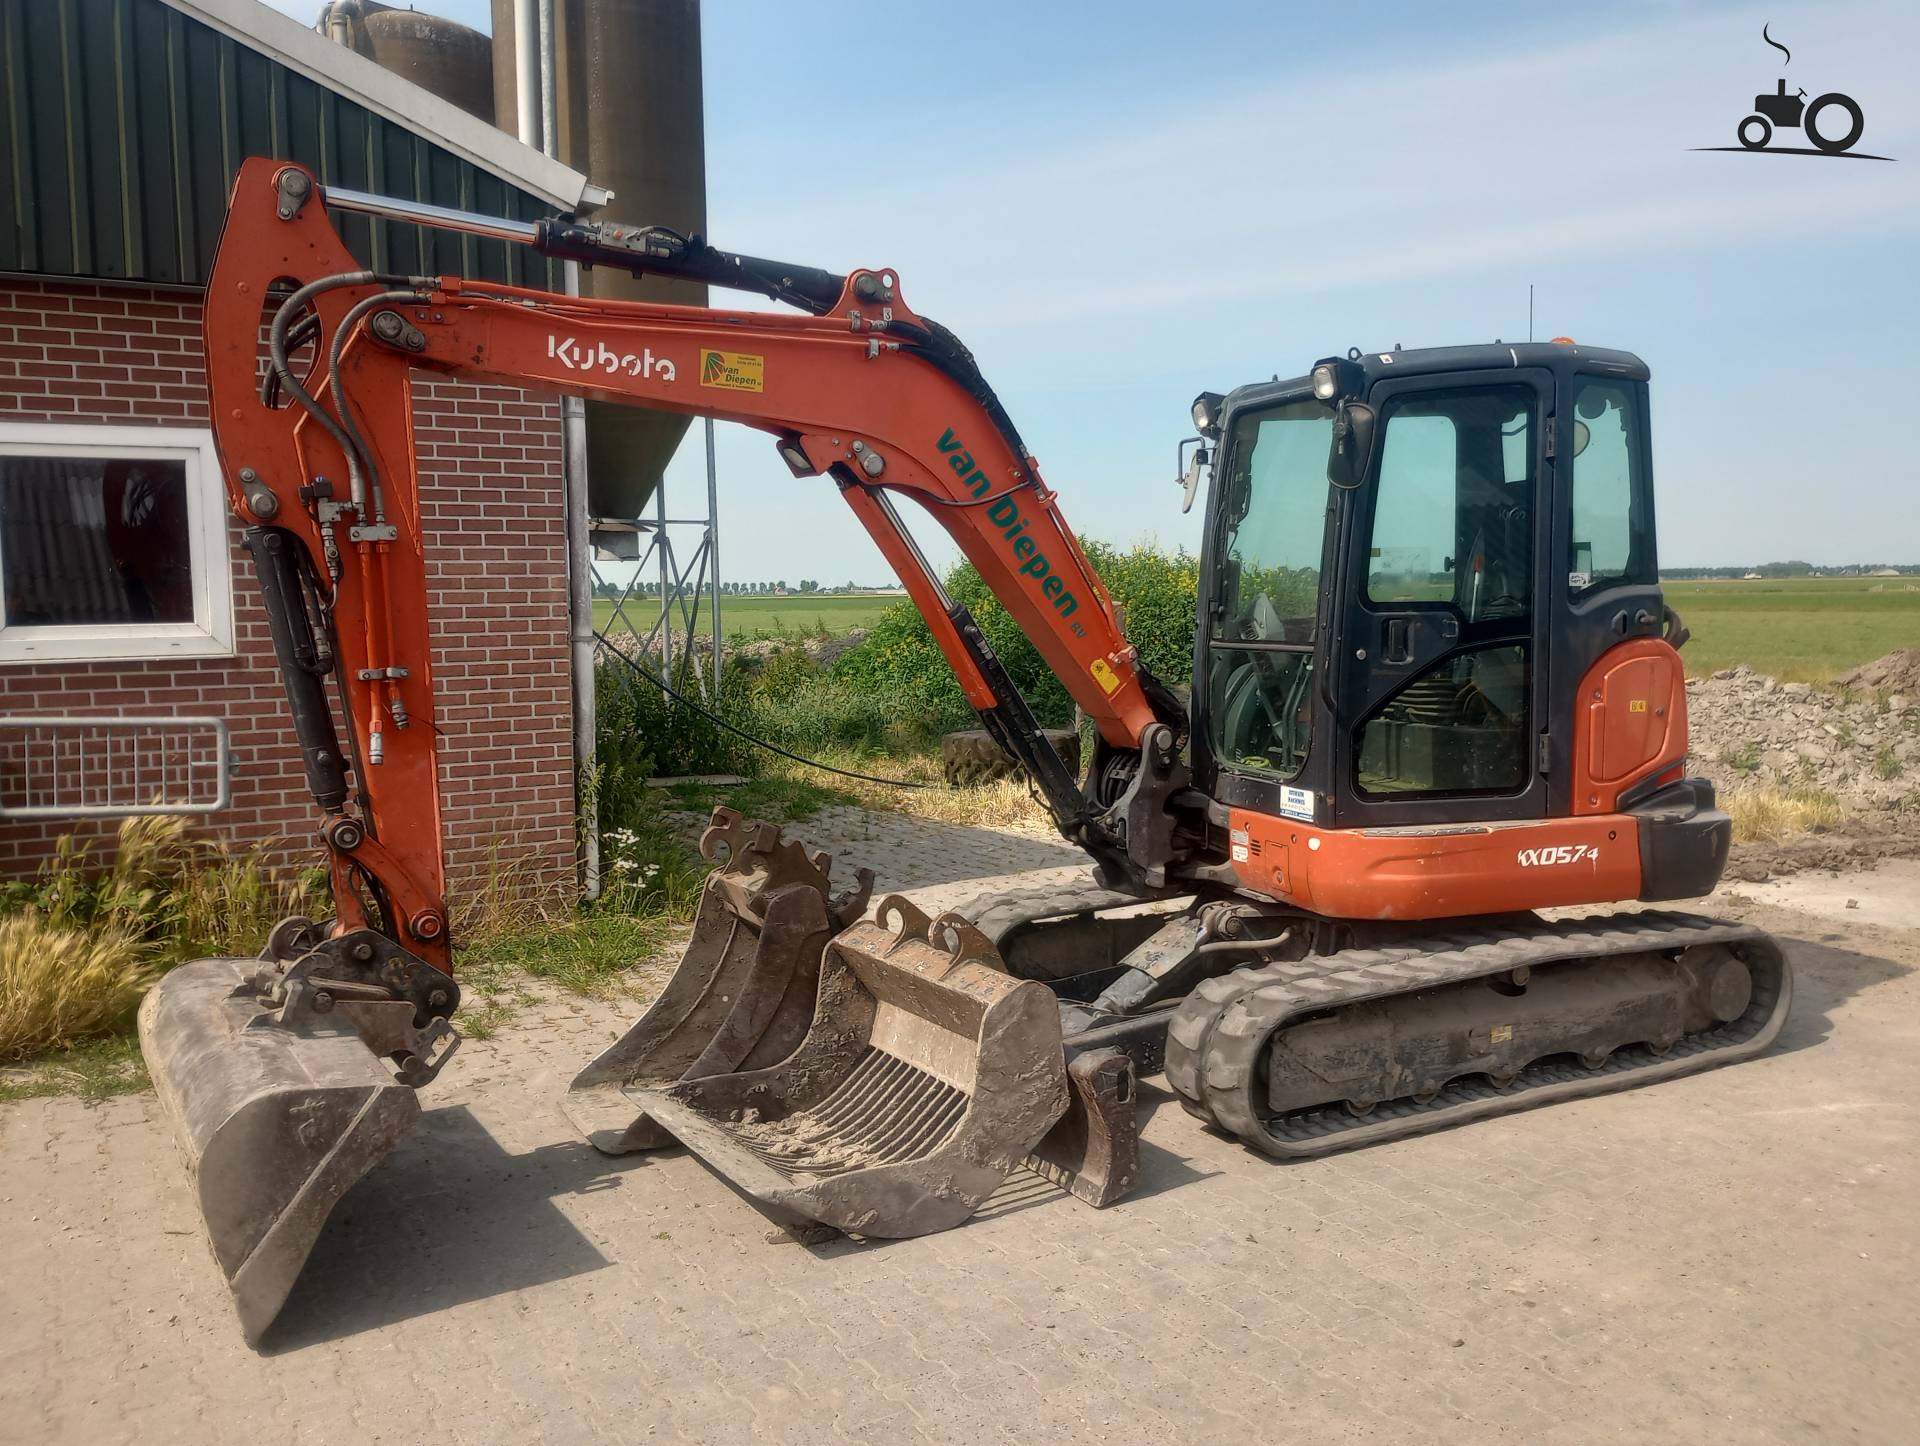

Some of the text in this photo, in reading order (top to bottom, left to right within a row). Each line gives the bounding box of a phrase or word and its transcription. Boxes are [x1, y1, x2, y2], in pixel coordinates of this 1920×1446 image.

[547, 335, 676, 382] Kubota
[725, 374, 757, 385] Diepen
[937, 428, 991, 497] van
[987, 498, 1077, 617] Diepen
